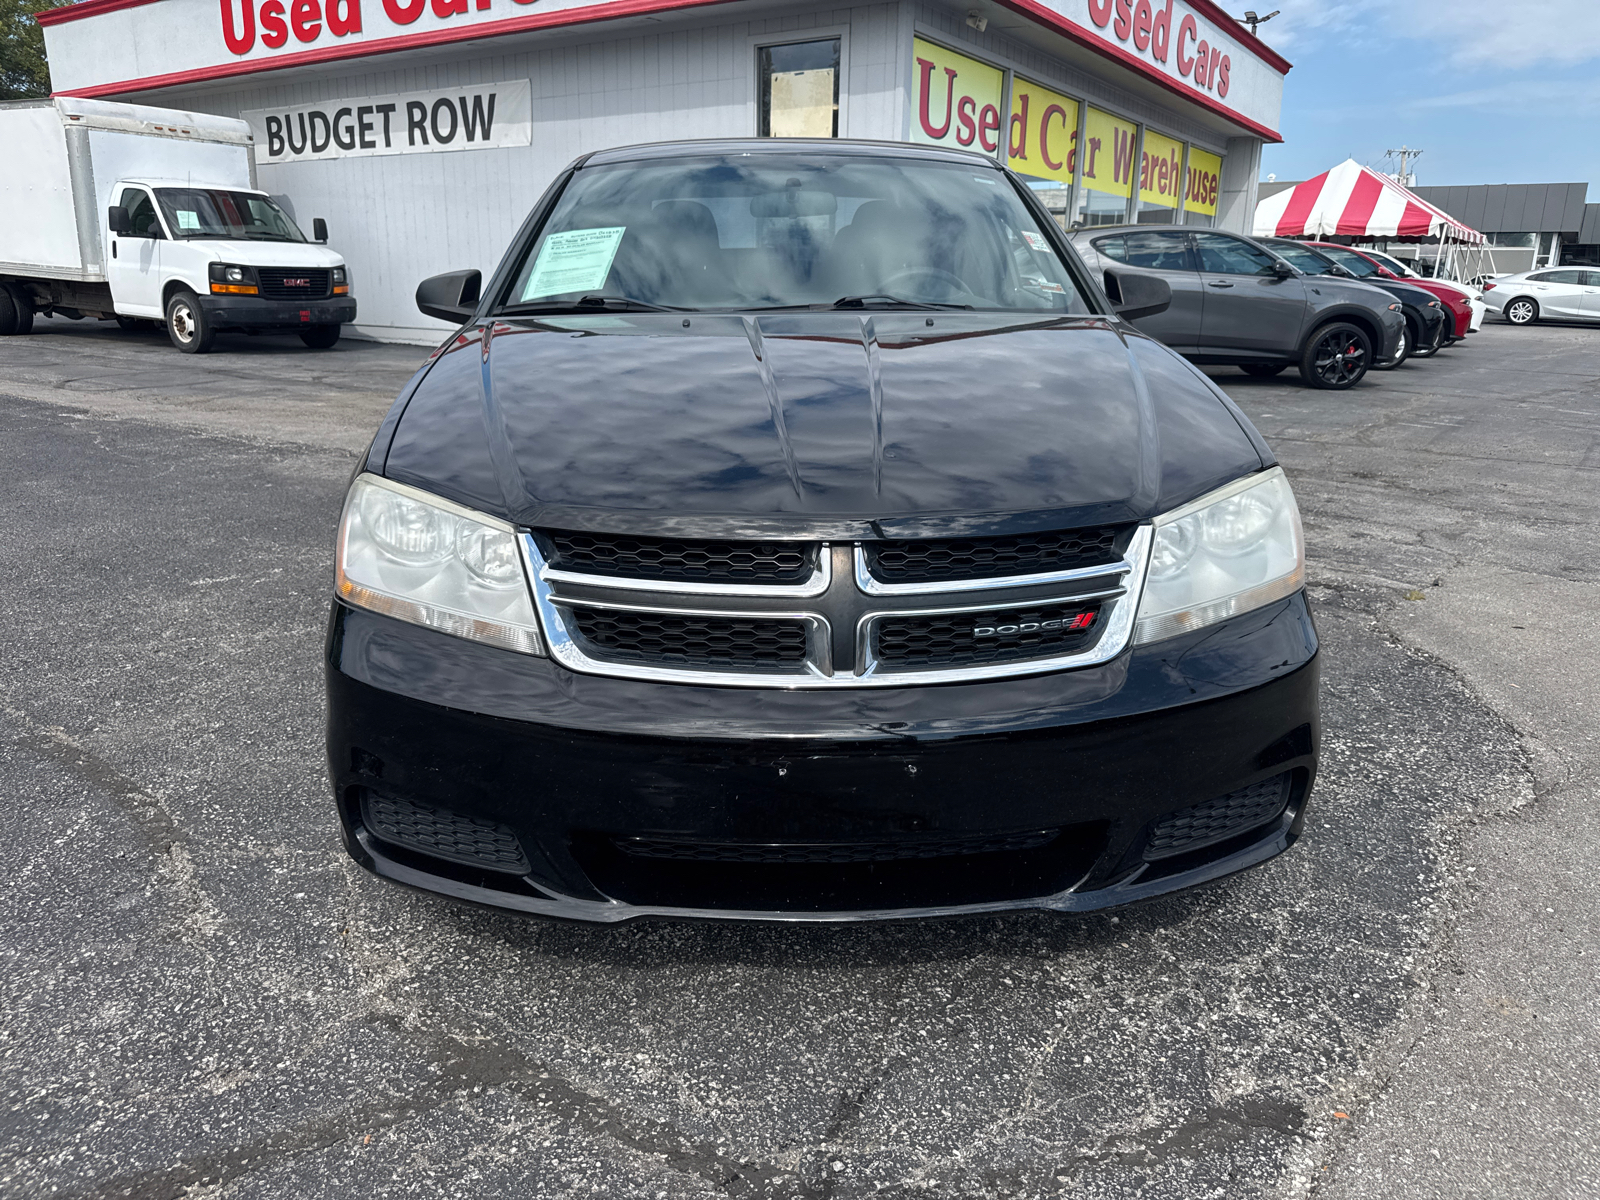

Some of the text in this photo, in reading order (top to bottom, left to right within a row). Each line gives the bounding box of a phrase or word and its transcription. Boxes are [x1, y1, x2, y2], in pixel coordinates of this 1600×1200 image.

[1177, 14, 1231, 97] Cars
[265, 93, 497, 156] BUDGET ROW
[916, 57, 1029, 160] Used
[1040, 104, 1101, 179] Car
[974, 617, 1080, 638] DODGE
